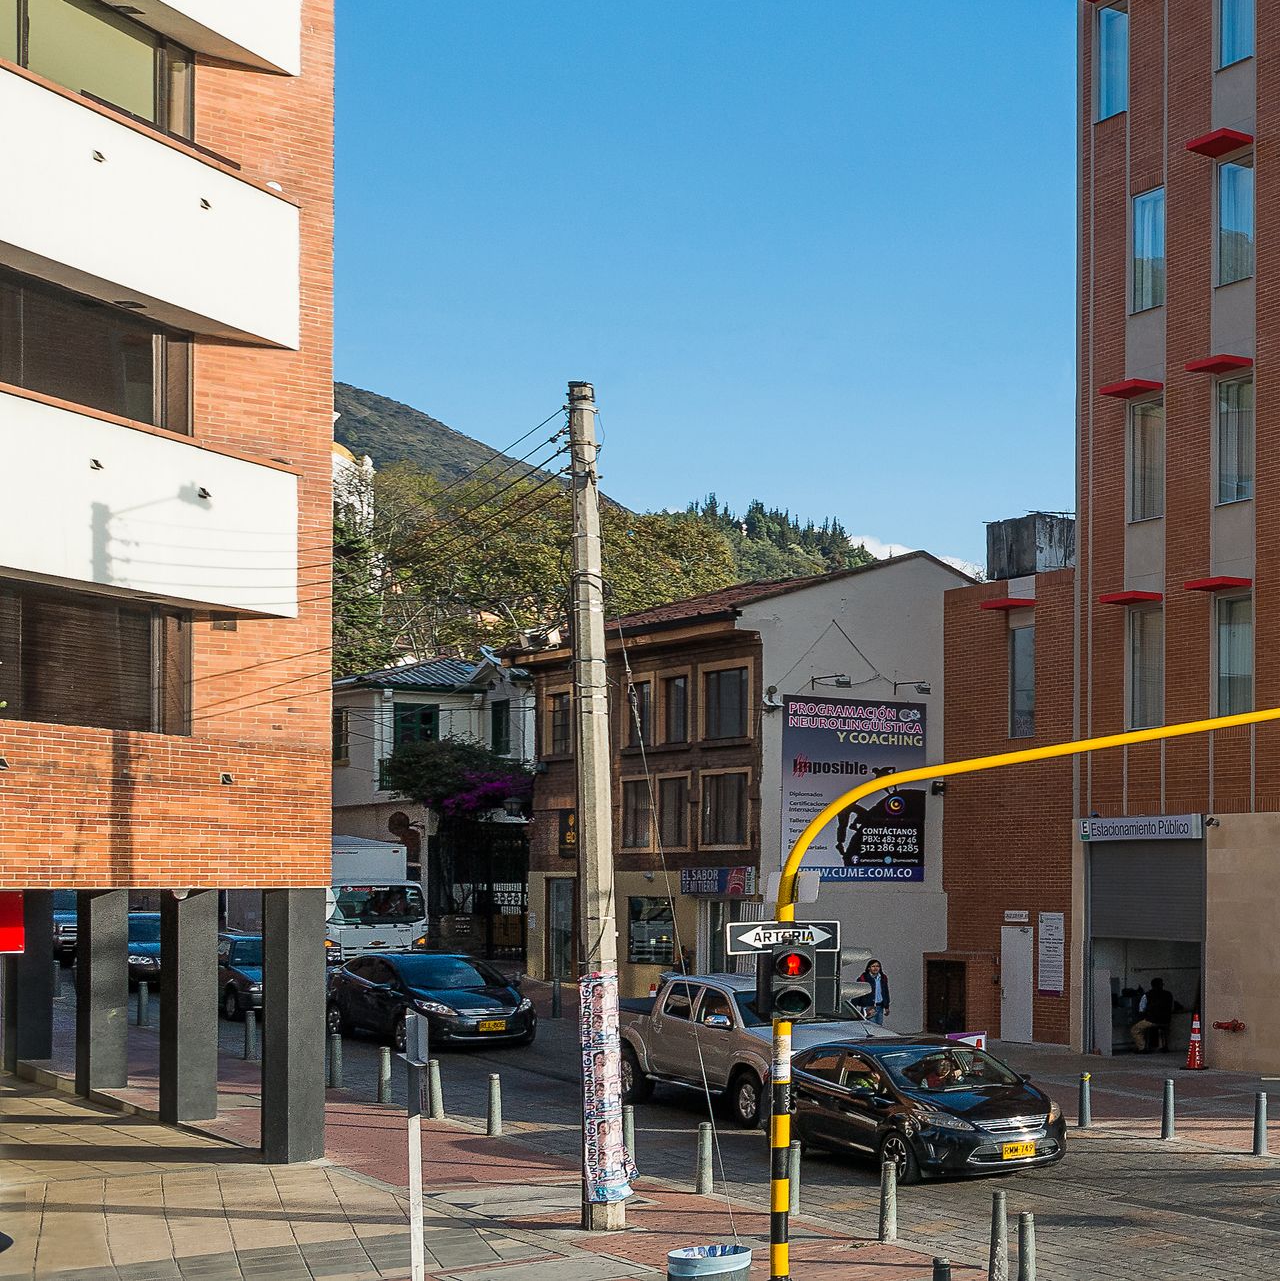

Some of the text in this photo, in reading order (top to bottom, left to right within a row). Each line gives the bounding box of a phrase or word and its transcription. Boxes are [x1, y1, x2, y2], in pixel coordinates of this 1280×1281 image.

[788, 702, 897, 720] PROGRAMACIÓN
[788, 716, 924, 734] NEUROLINGÜÍSTICA
[837, 731, 924, 747] Y COACHING
[862, 826, 918, 836] CONTÁCTANOS
[1082, 819, 1189, 837] E Estacionamiento Público
[862, 835, 917, 845] PBX: 482 47 46
[860, 843, 919, 854] 312 286 4285
[682, 869, 719, 881] EL SABOR
[798, 868, 913, 878] W.CUME.COM.CO
[698, 880, 719, 893] TIERRA
[582, 983, 592, 1048] BURUNDANGA
[583, 1051, 596, 1116] BURUNDANGA
